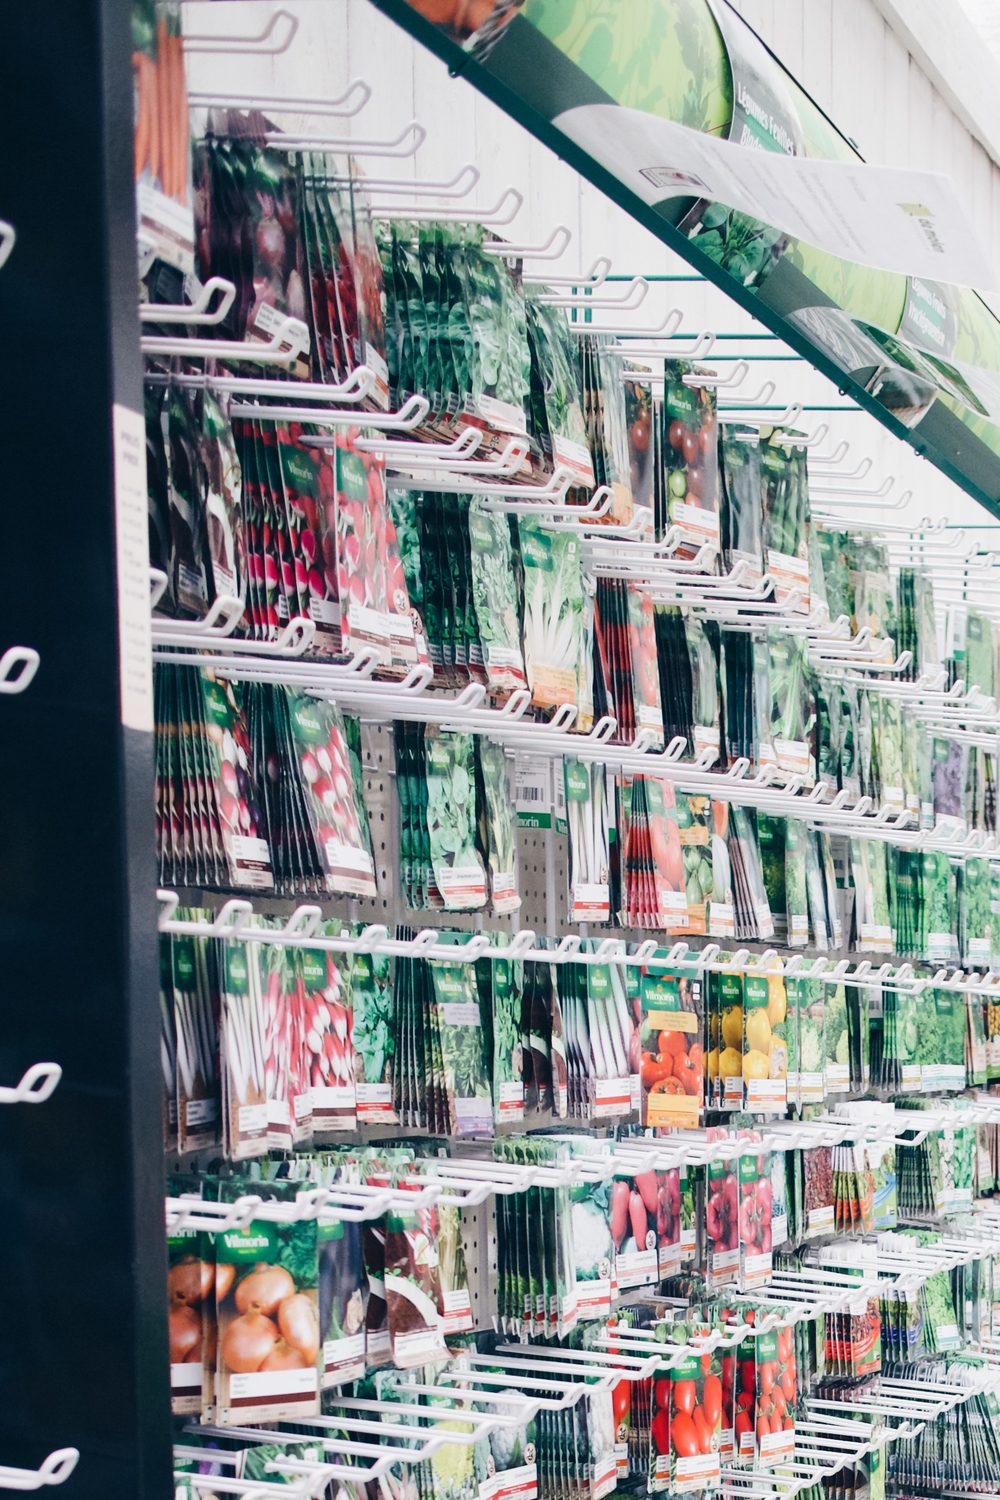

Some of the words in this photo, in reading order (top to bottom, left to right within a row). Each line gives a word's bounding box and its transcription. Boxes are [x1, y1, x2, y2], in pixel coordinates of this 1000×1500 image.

[738, 82, 769, 130] Légumes
[668, 393, 691, 411] Vilmorin
[289, 460, 313, 480] Vilmorin
[342, 465, 363, 485] Vilmorin
[522, 542, 547, 559] Vilmorin
[295, 713, 321, 730] Vilmorin
[568, 780, 586, 789] Vilmorin
[438, 982, 463, 992] Vilmorin
[722, 983, 740, 994] Vilmorin
[747, 986, 766, 997] Vilmorin
[645, 990, 674, 1002] Vilmorin
[224, 1234, 269, 1248] Vilmorin
[759, 1343, 775, 1352] Vilmorin
